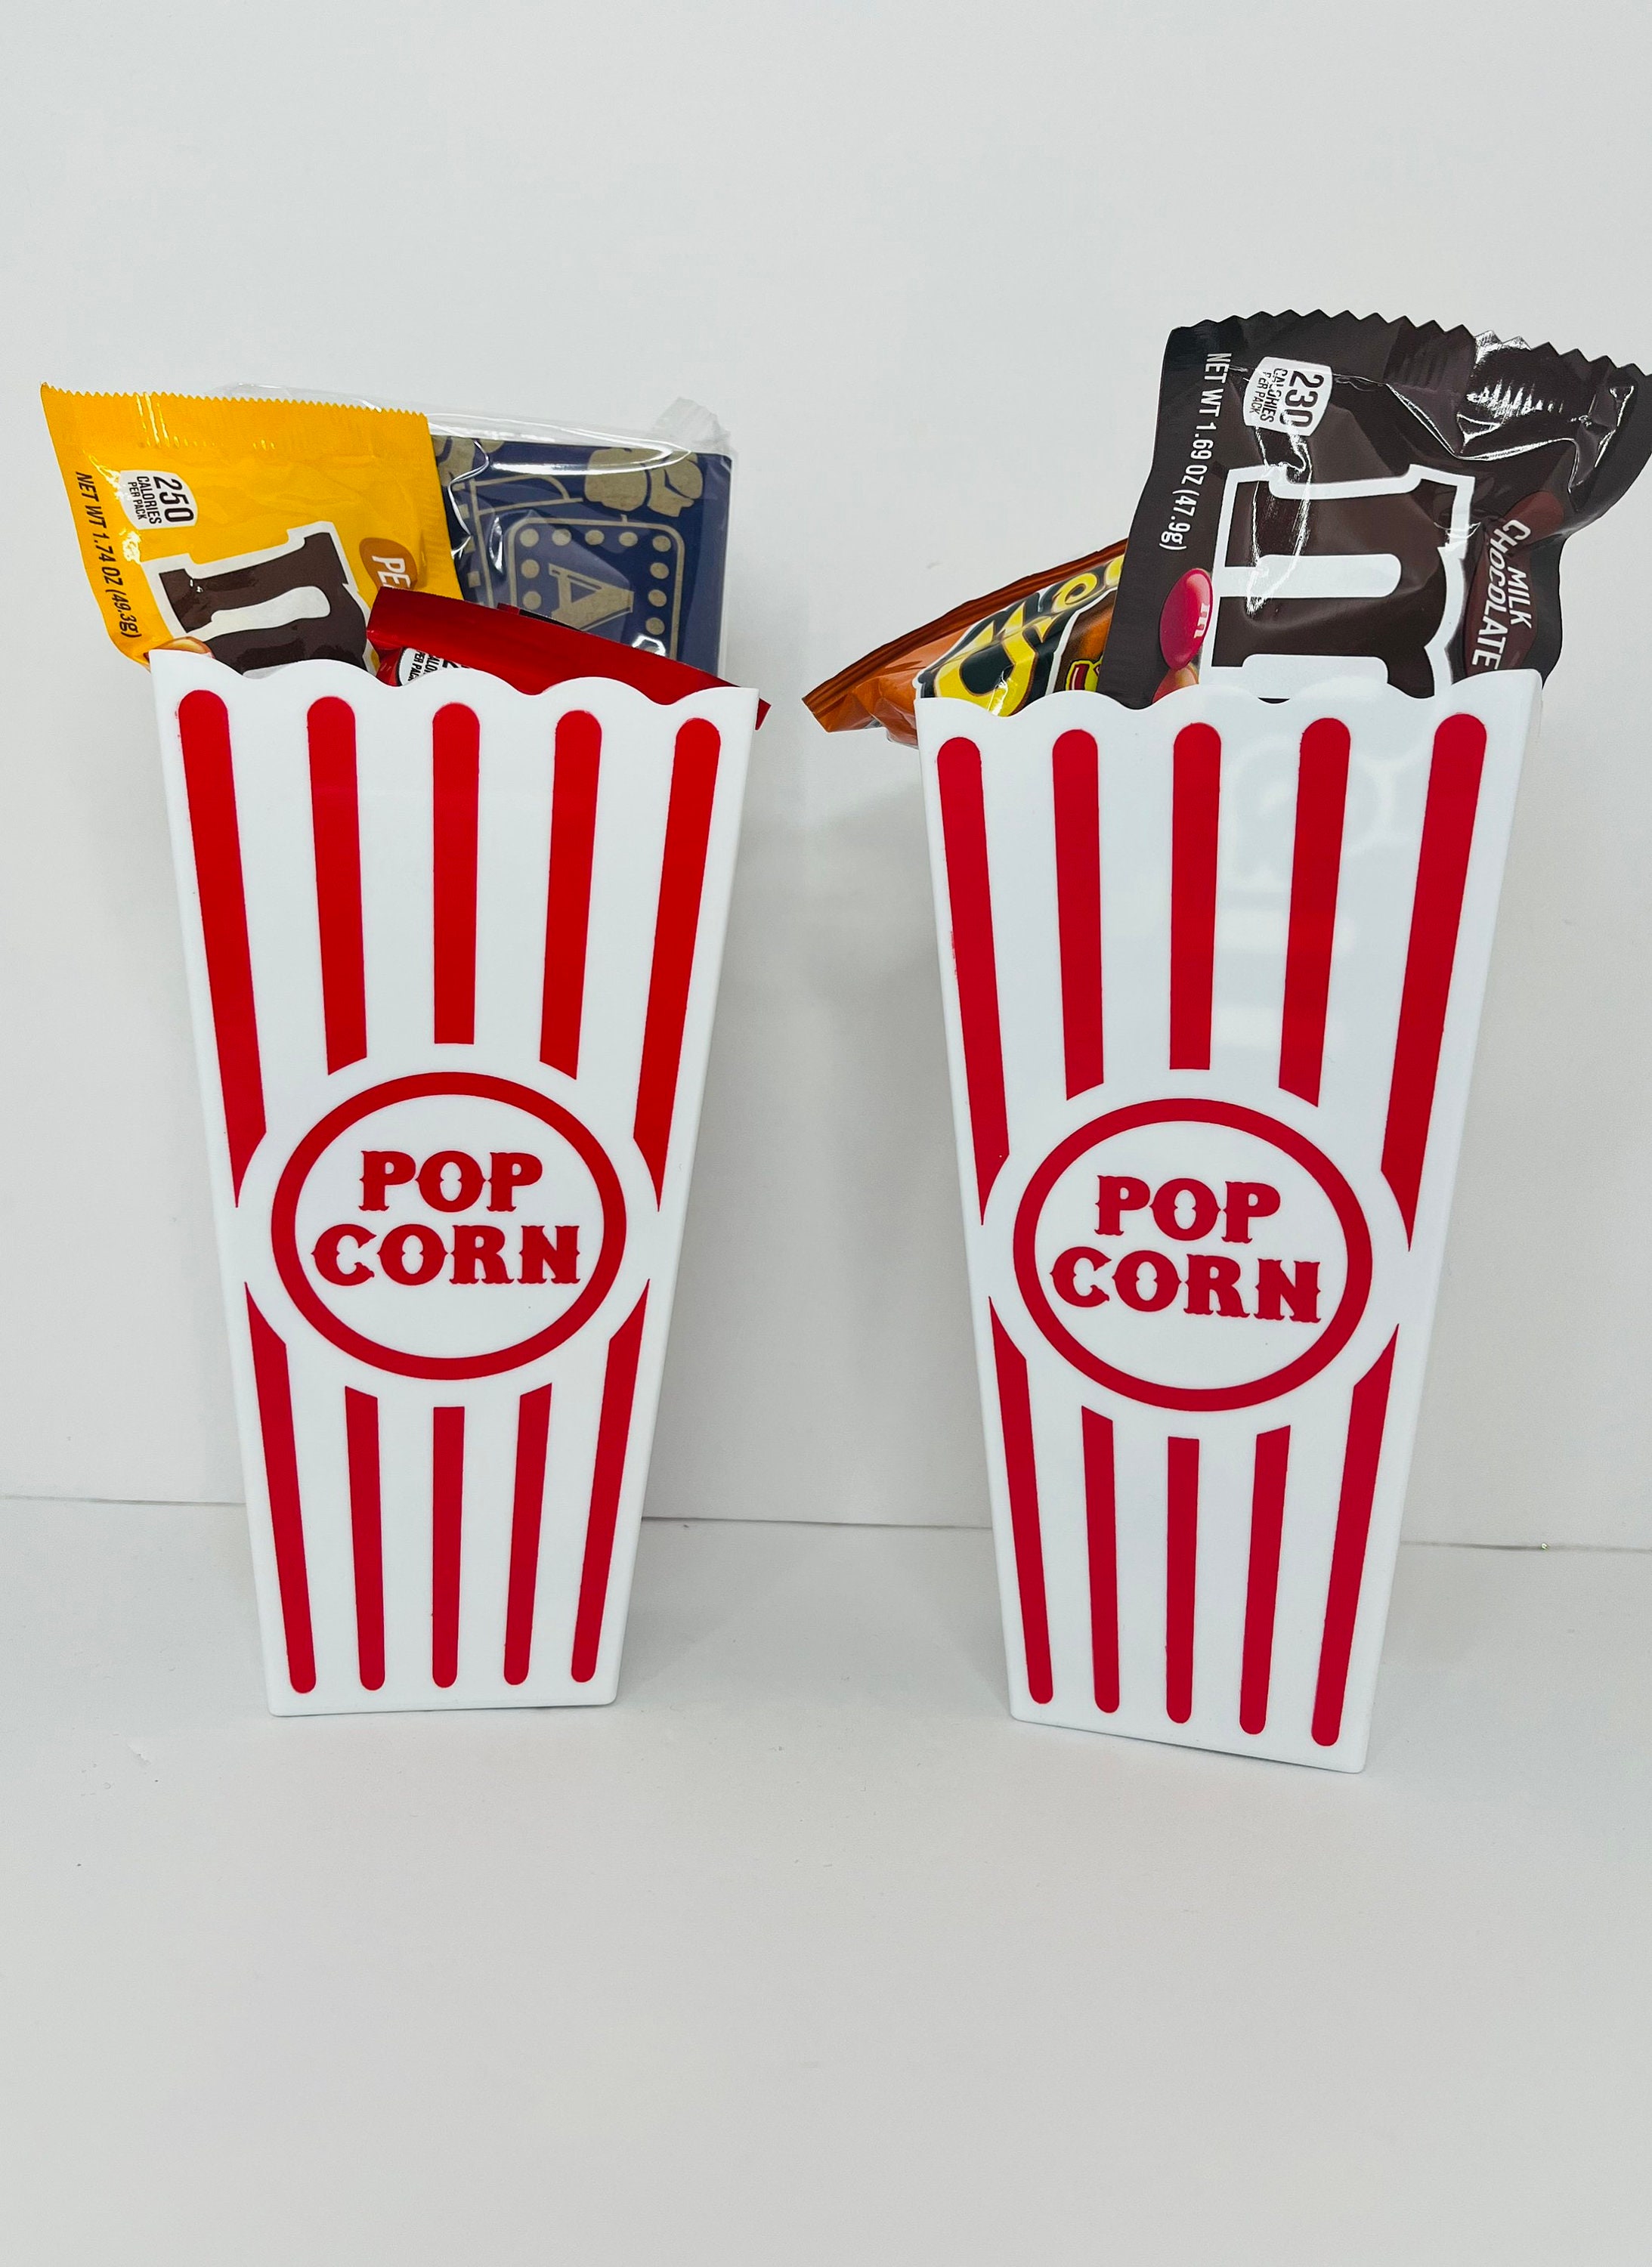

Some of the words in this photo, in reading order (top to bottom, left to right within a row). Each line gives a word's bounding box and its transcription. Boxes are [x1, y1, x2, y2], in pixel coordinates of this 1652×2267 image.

[1204, 352, 1232, 384] NET
[1256, 371, 1272, 390] PER
[1199, 388, 1224, 417] WT
[1249, 391, 1267, 415] PACK
[1279, 370, 1325, 428] 230
[1190, 422, 1217, 459] 1.69
[76, 471, 100, 503] NET
[128, 481, 141, 497] PER
[1180, 465, 1208, 485] OZ
[85, 505, 107, 529] WT
[133, 499, 147, 521] PACK
[136, 476, 162, 524] CALORIES
[153, 476, 194, 523] 250
[1159, 489, 1200, 550] (47.9g)
[92, 533, 116, 562] 1.74
[101, 567, 123, 586] OZ
[371, 555, 412, 589] PE
[1471, 519, 1531, 670] CHOCOLATE
[1507, 566, 1532, 629] MILK
[105, 589, 142, 638] (49.3g)
[358, 1150, 543, 1213] POP
[1094, 1174, 1281, 1244] POP
[311, 1223, 581, 1286] CORN
[1049, 1246, 1322, 1323] CORN
